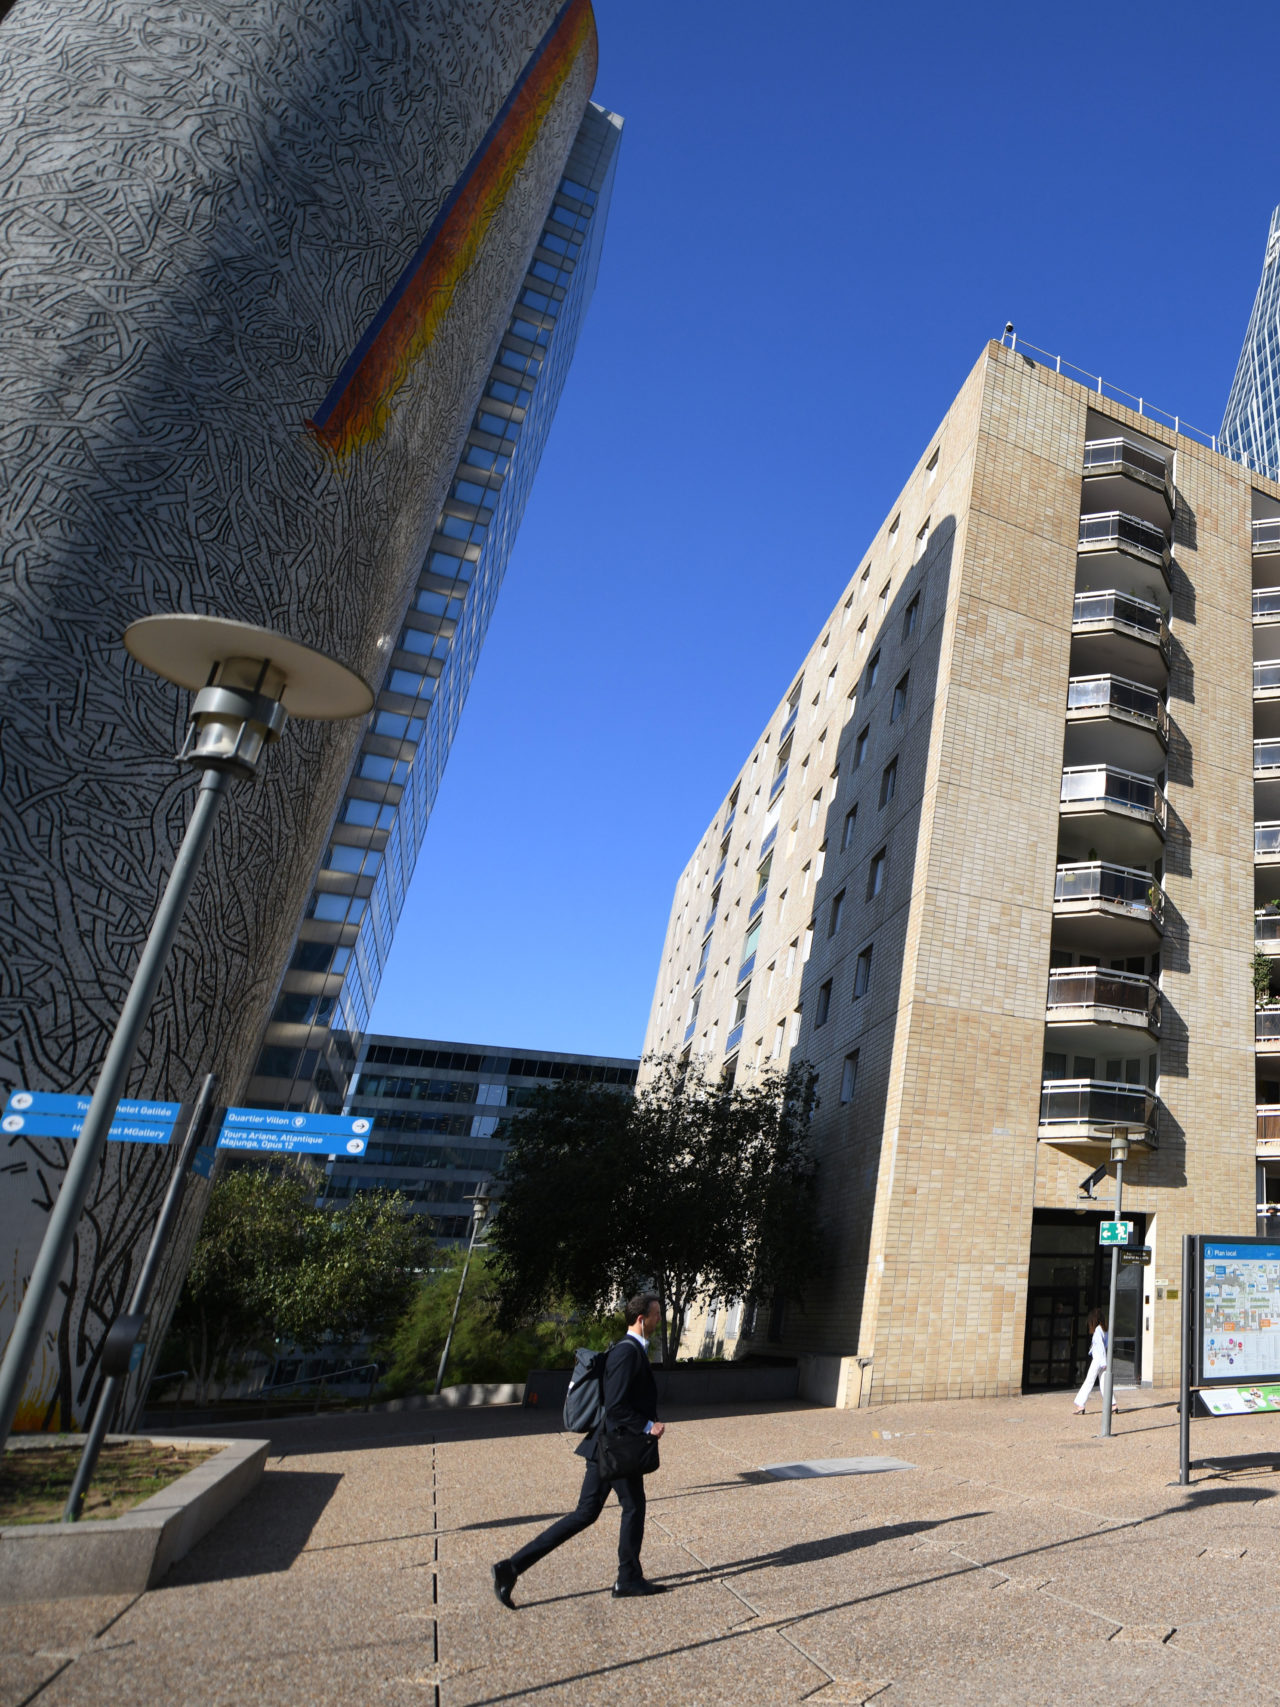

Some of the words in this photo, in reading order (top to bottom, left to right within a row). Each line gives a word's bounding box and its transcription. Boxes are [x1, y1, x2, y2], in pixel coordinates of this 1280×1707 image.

[140, 1106, 172, 1117] Galilée
[228, 1113, 264, 1123] Quartier
[266, 1116, 289, 1125] Villon
[223, 1130, 247, 1139] Tours
[248, 1131, 278, 1142] Ariane,
[280, 1134, 323, 1144] Atlantique
[220, 1138, 259, 1148] Majunga,
[261, 1140, 283, 1149] Opus
[285, 1142, 294, 1150] 12
